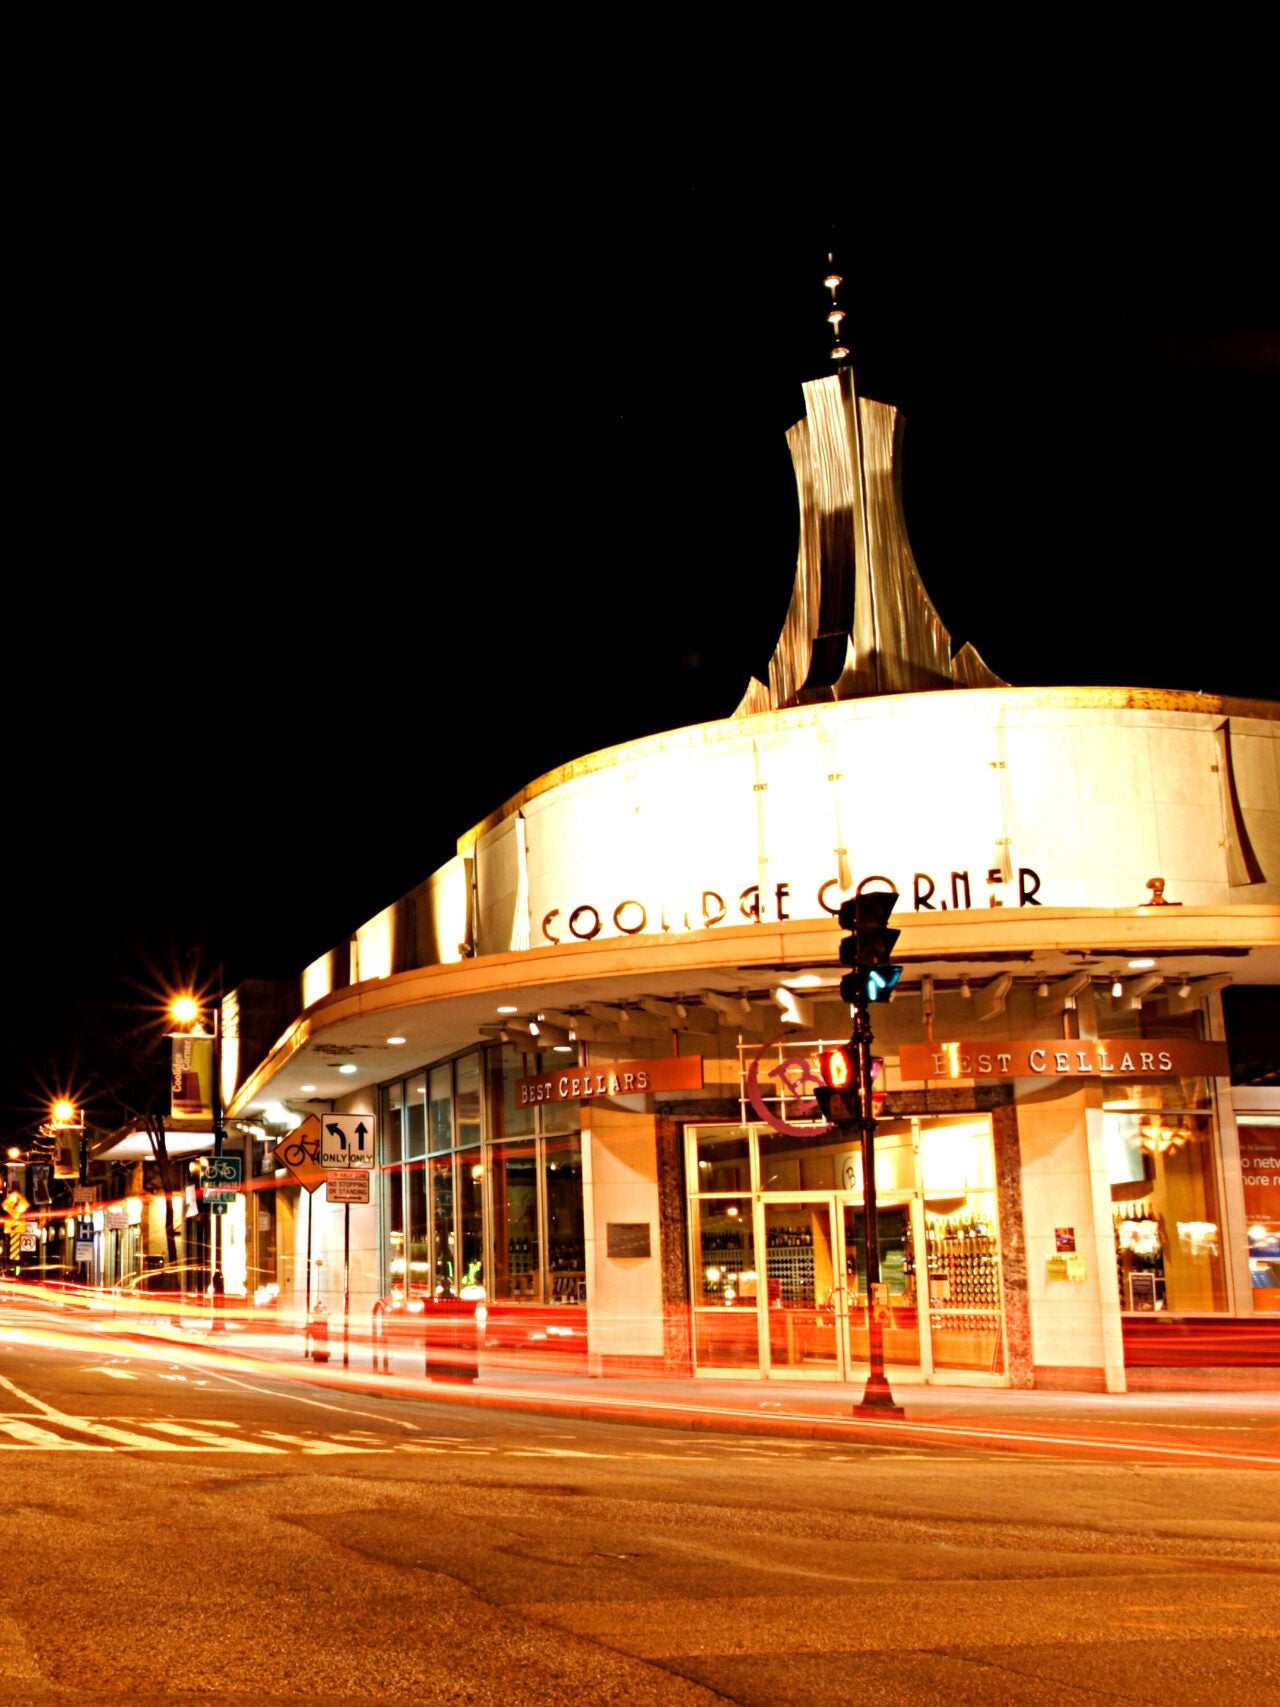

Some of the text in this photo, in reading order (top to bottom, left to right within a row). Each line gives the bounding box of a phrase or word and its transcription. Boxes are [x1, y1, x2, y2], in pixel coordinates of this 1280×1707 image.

[182, 1039, 191, 1071] Corner
[932, 1049, 1173, 1075] BEST CELLARS
[171, 1053, 183, 1092] Coolidge
[521, 1072, 648, 1104] BEST CELLARS
[322, 1153, 372, 1164] ONLY ONLY
[338, 1188, 368, 1196] STANDING
[80, 1224, 90, 1238] H
